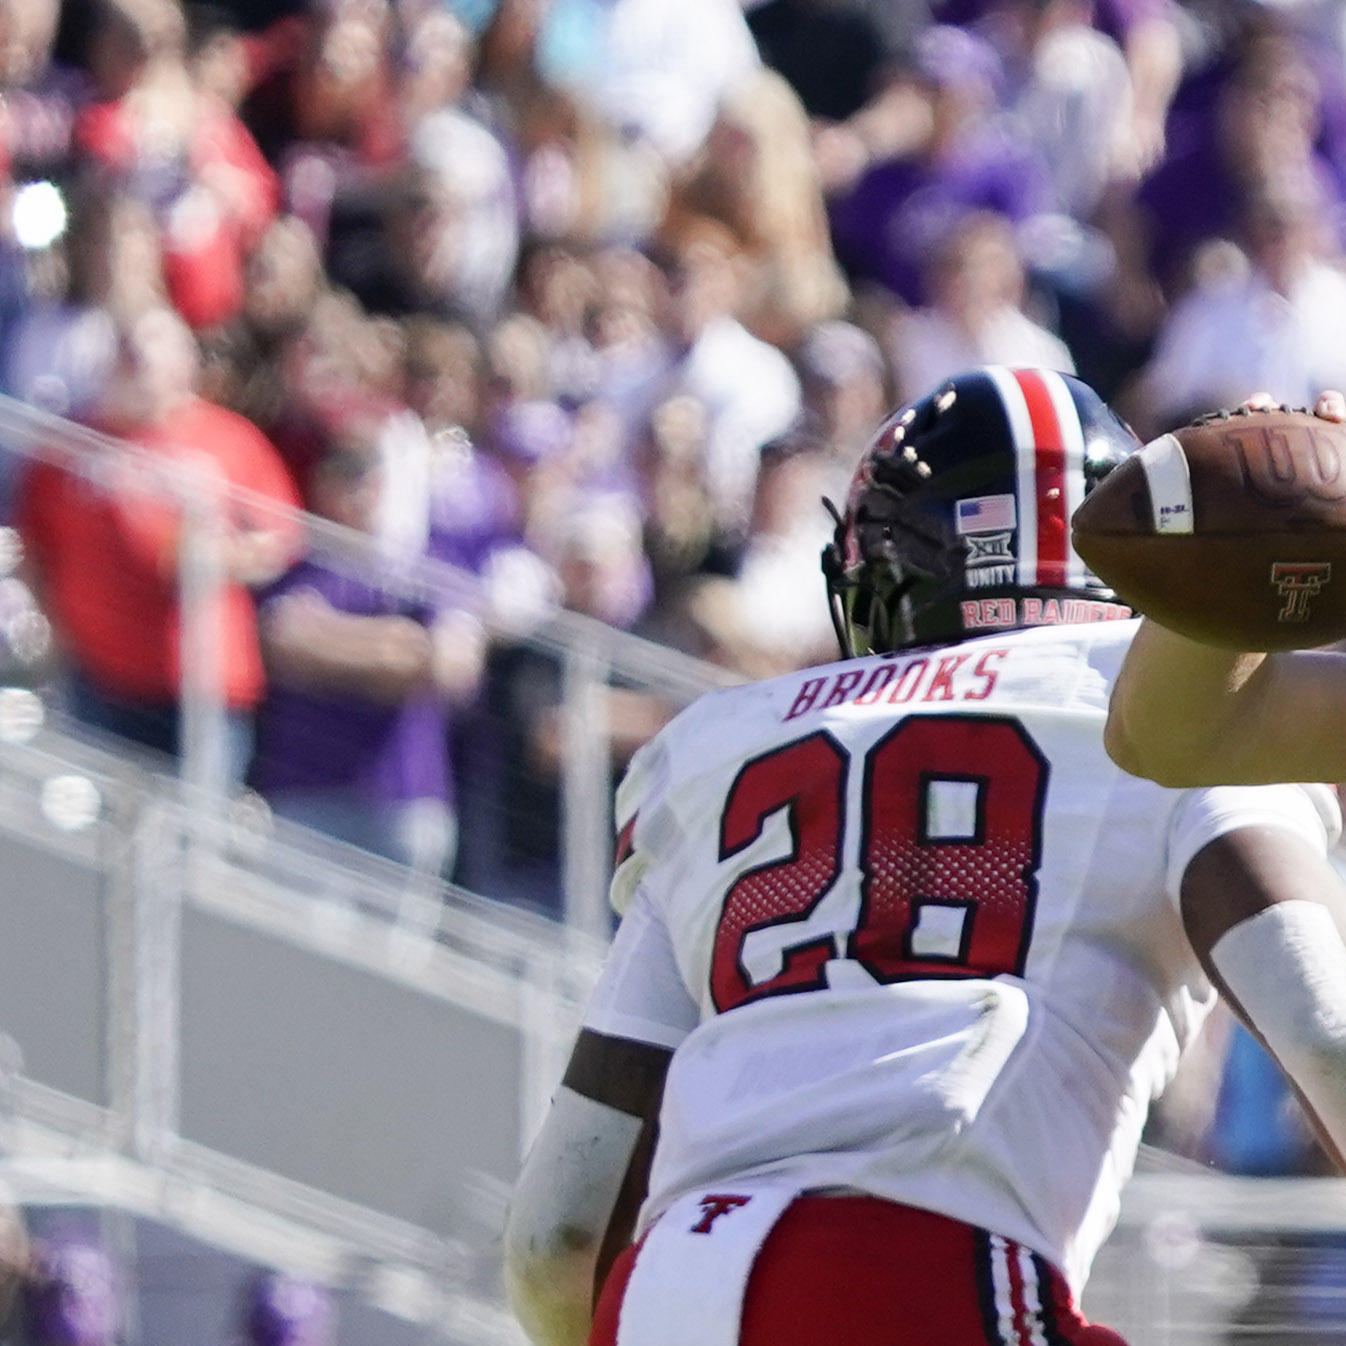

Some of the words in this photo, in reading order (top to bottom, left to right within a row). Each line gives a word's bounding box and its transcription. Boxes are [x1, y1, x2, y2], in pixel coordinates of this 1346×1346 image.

[966, 564, 1017, 588] UNITY
[960, 599, 1017, 629] RED
[783, 649, 1011, 723] BROOKS
[710, 713, 1051, 1015] 28
